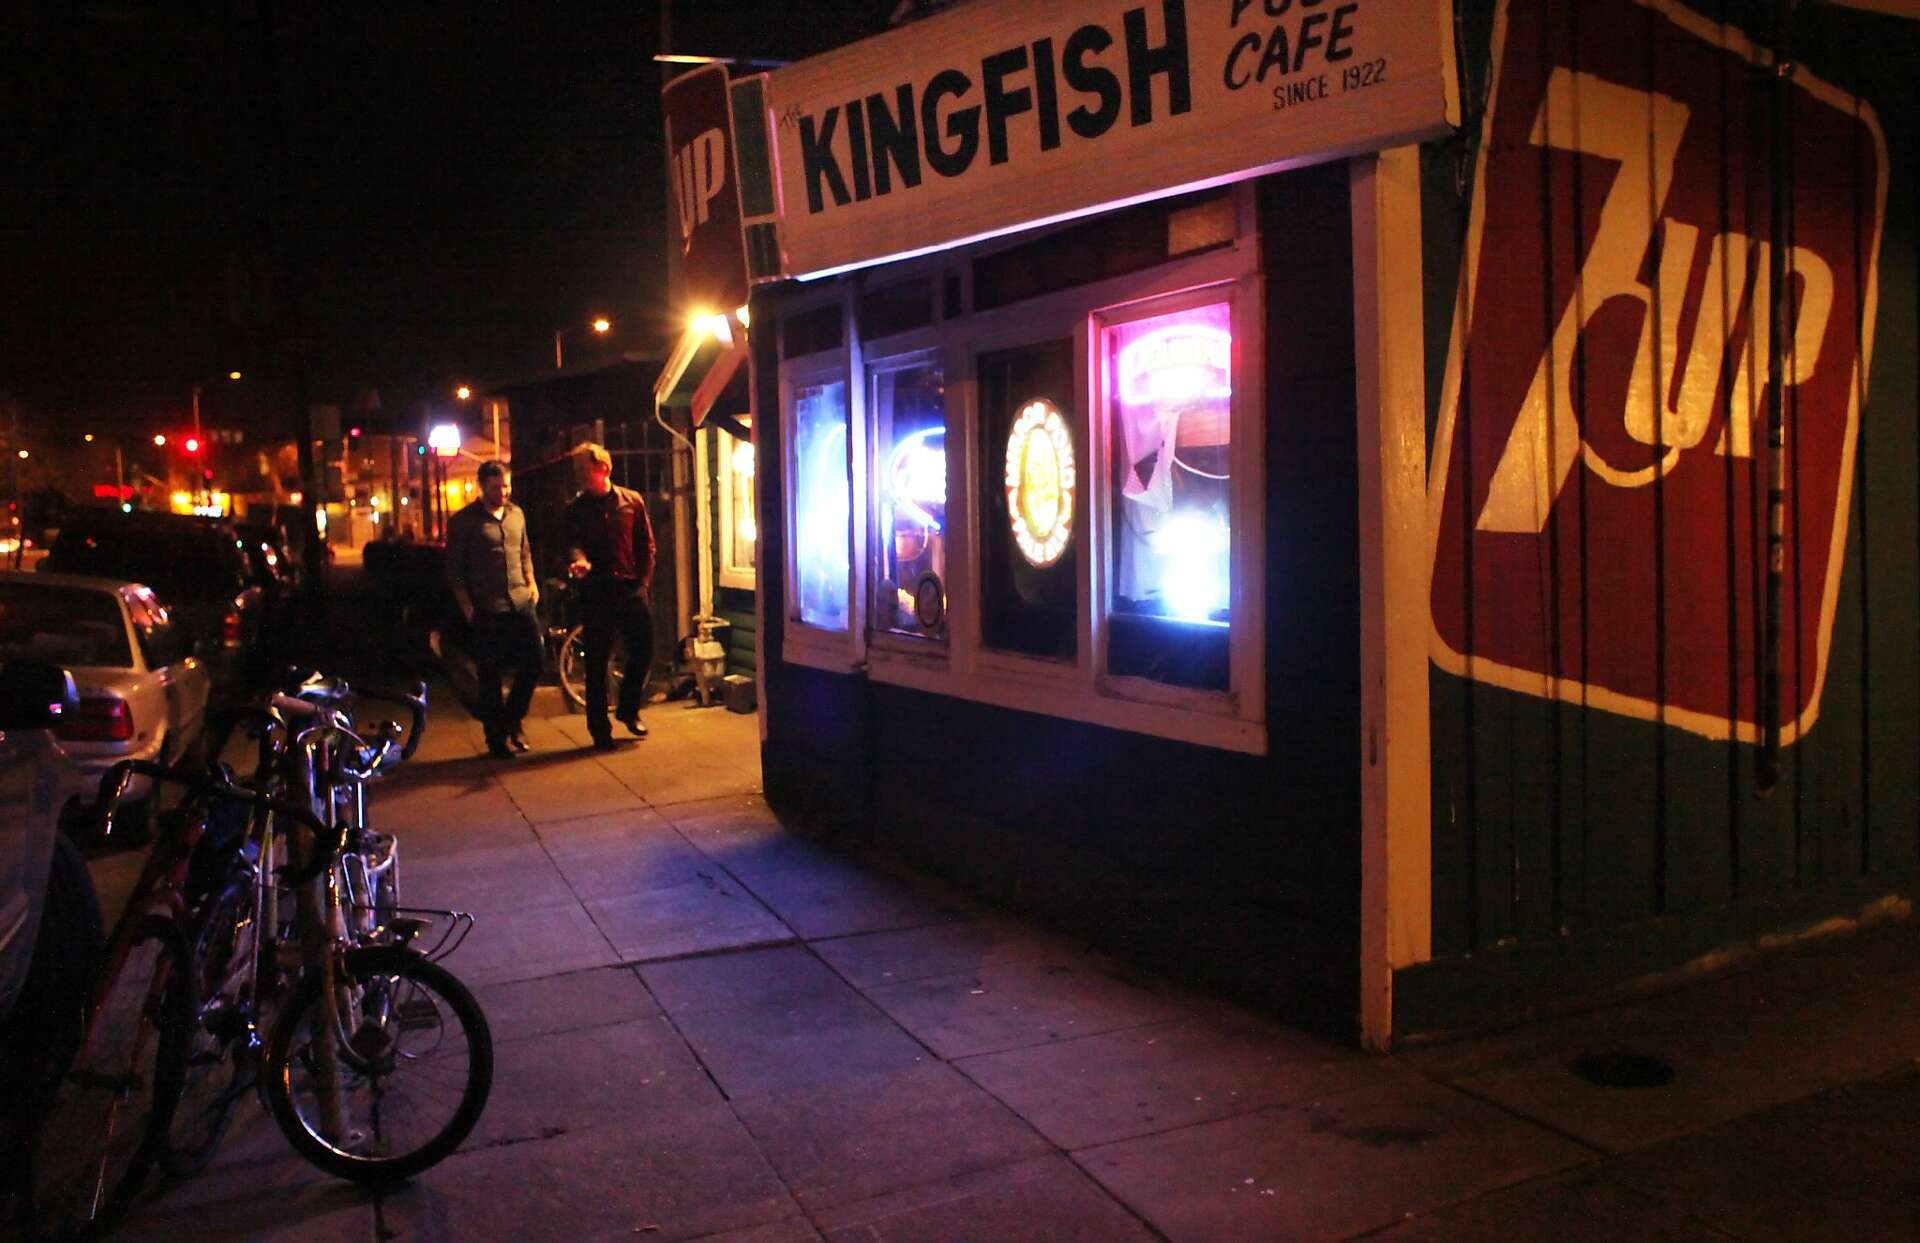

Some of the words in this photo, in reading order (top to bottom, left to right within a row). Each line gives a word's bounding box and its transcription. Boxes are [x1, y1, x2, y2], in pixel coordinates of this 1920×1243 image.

[1224, 4, 1359, 90] CAFE
[1273, 75, 1329, 110] SINCE
[1343, 58, 1387, 92] 1922
[800, 0, 1191, 214] KINGFISH
[668, 119, 726, 247] UP
